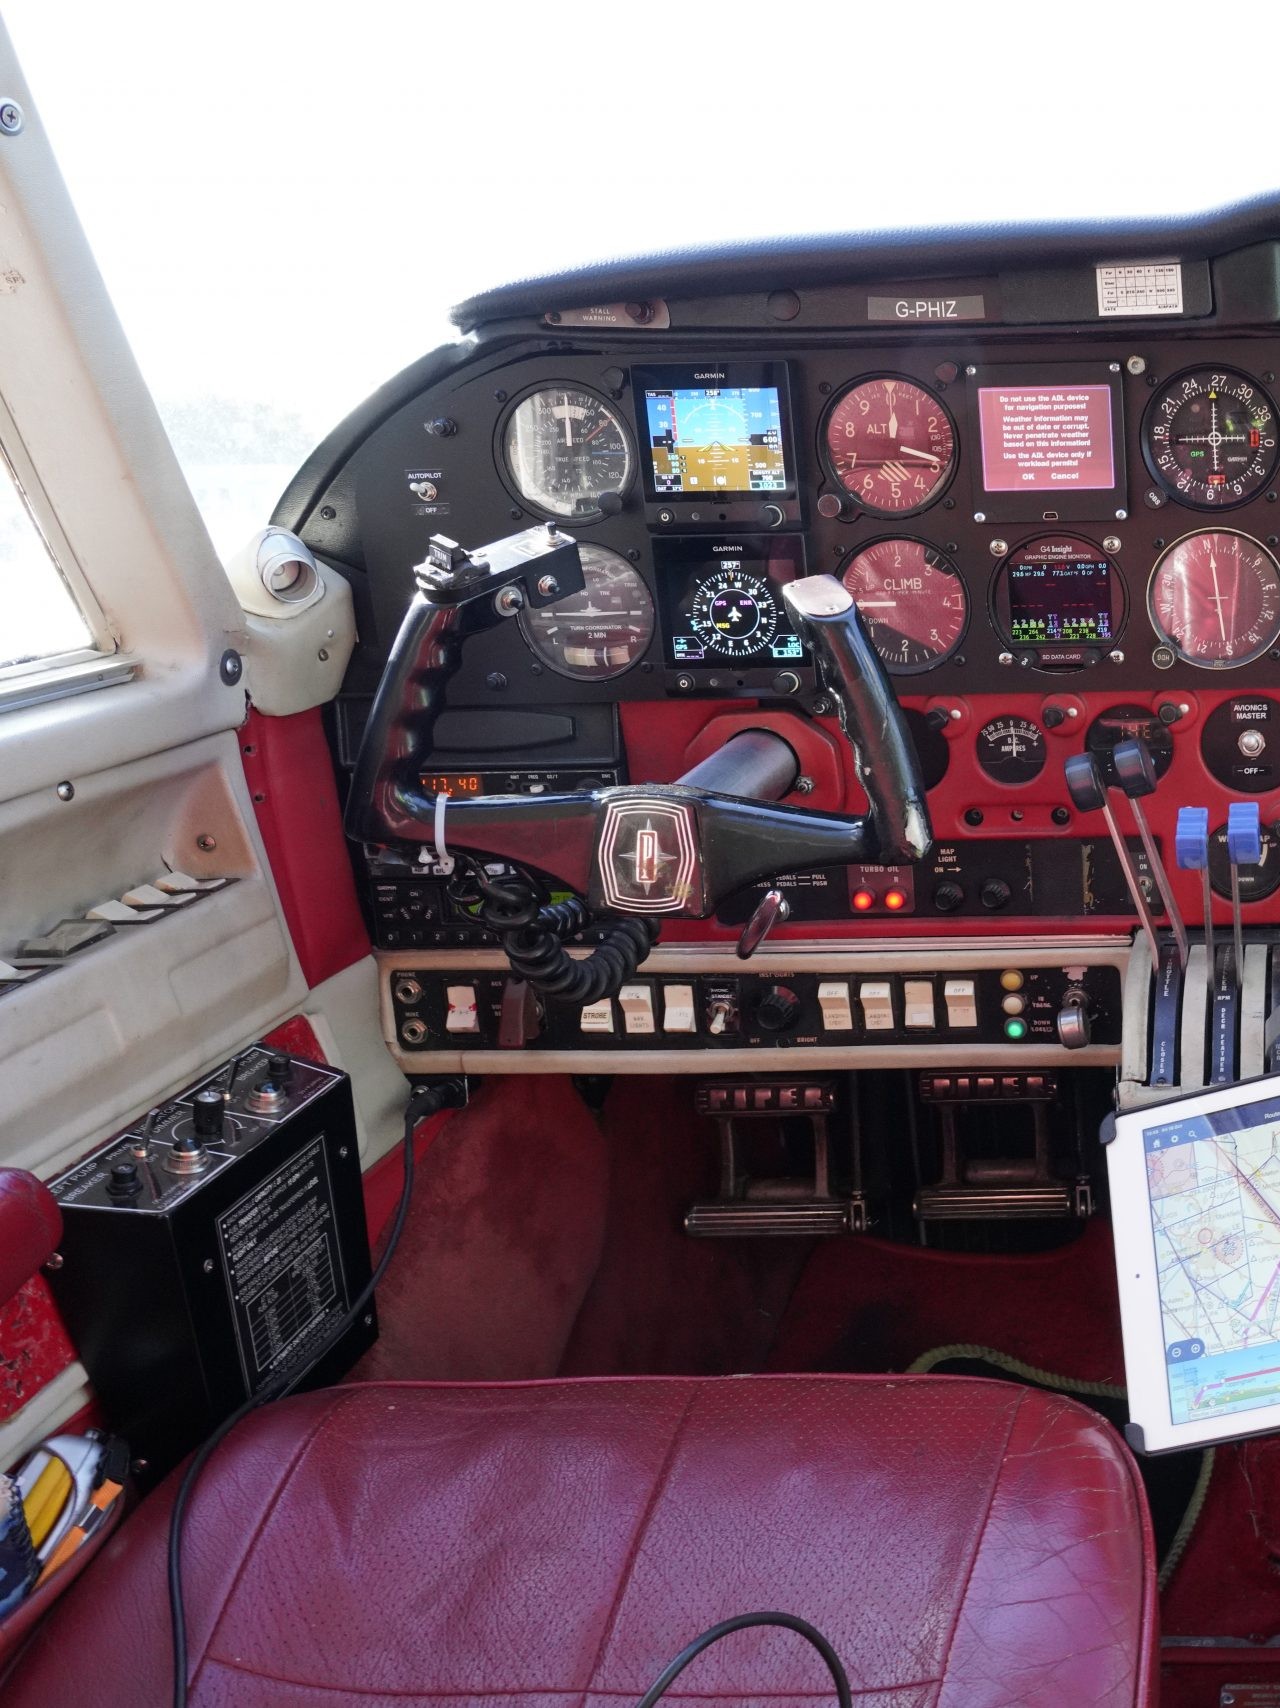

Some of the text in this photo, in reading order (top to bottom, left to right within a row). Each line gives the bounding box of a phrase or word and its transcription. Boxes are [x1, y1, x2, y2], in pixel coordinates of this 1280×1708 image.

[895, 301, 958, 318] G-PHIZ
[1182, 378, 1198, 394] 24
[1212, 375, 1226, 386] 27
[1238, 384, 1253, 399] 30
[860, 400, 870, 415] 9
[1162, 397, 1176, 413] 21
[1257, 405, 1271, 422] 33
[846, 422, 854, 437] 8
[867, 424, 887, 434] ALT
[928, 417, 938, 432] 2
[1154, 426, 1164, 441] 18
[864, 475, 873, 489] 6
[891, 483, 901, 498] 5
[1149, 492, 1160, 505] OBS
[884, 578, 922, 590] CLIMB
[1264, 1111, 1280, 1119] Route
